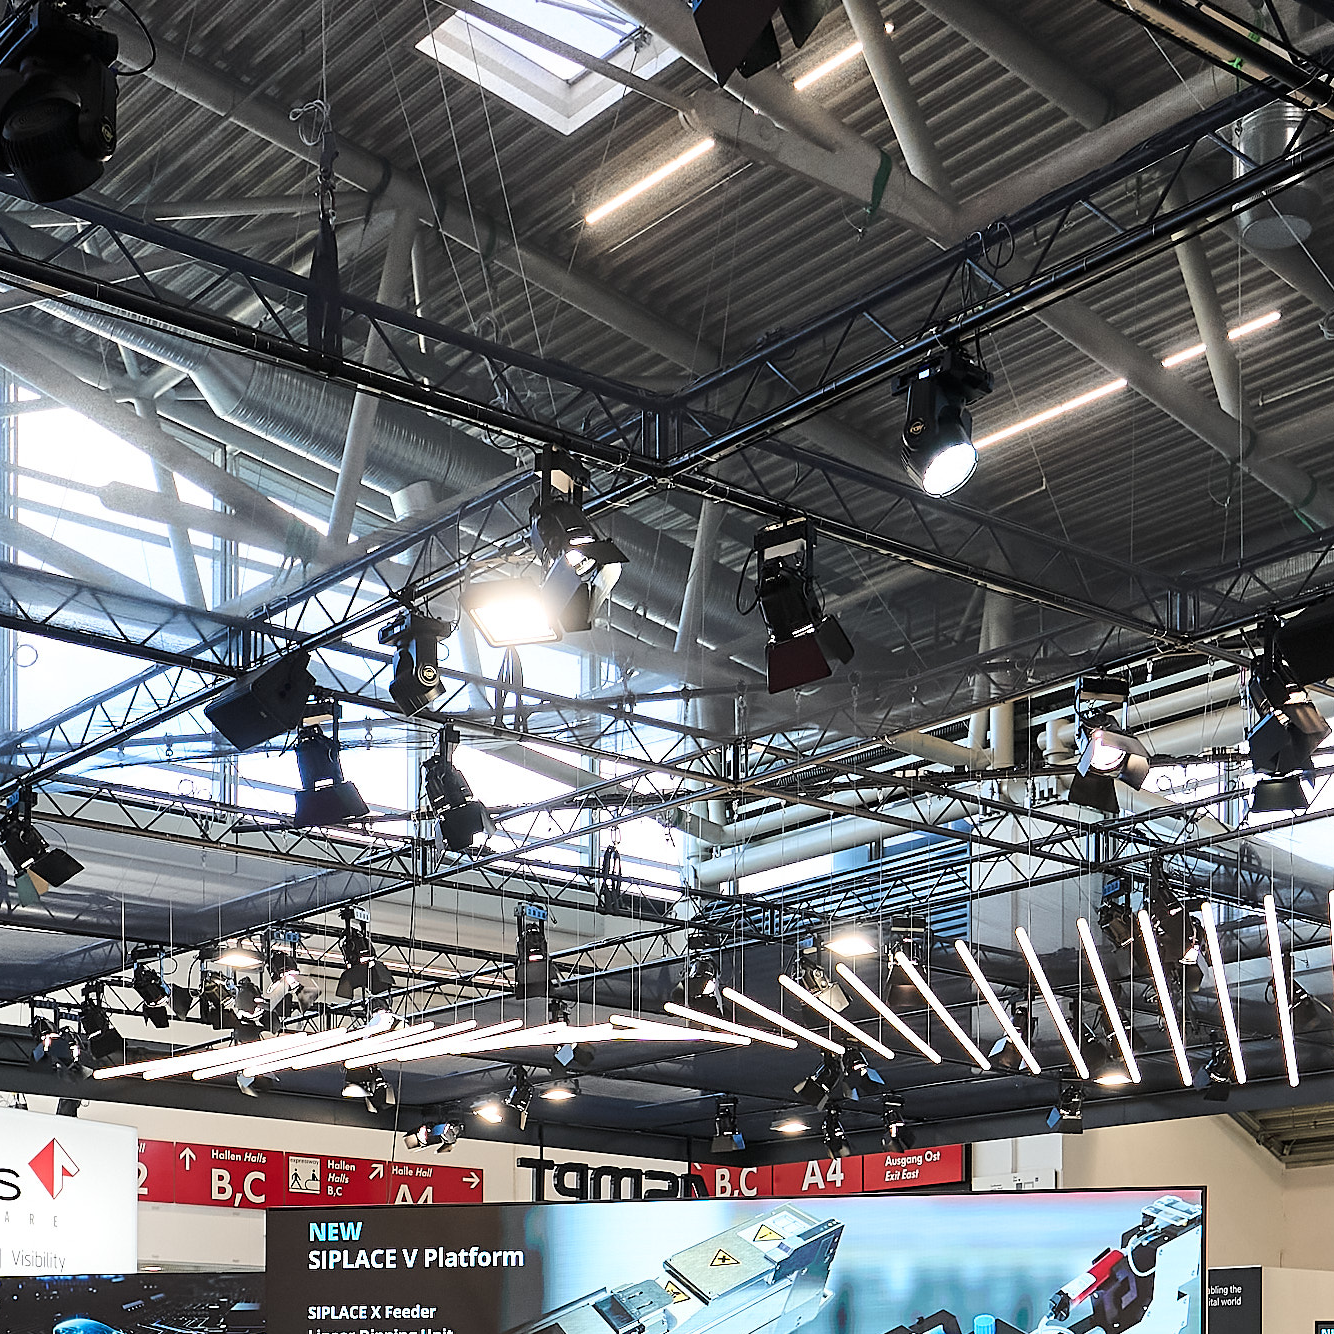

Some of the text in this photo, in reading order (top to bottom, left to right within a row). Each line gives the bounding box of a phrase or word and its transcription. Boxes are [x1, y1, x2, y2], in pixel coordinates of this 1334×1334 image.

[210, 1149, 267, 1164] Hallen Halls
[884, 1151, 941, 1168] Ausgang Ost
[327, 1159, 356, 1171] Hallen
[390, 1165, 433, 1178] Halle Hall
[327, 1172, 350, 1184] Halls
[801, 1158, 845, 1192] A4
[884, 1168, 919, 1182] Exit East
[210, 1168, 266, 1208] B,C
[327, 1185, 343, 1197] B,C
[308, 1221, 363, 1242] NEW
[11, 1250, 67, 1273] Visibility
[307, 1246, 525, 1270] SIPLACE V Platform
[1230, 1285, 1243, 1294] the
[1221, 1297, 1242, 1306] world
[307, 1304, 437, 1320] SIPLACE X Feeder
